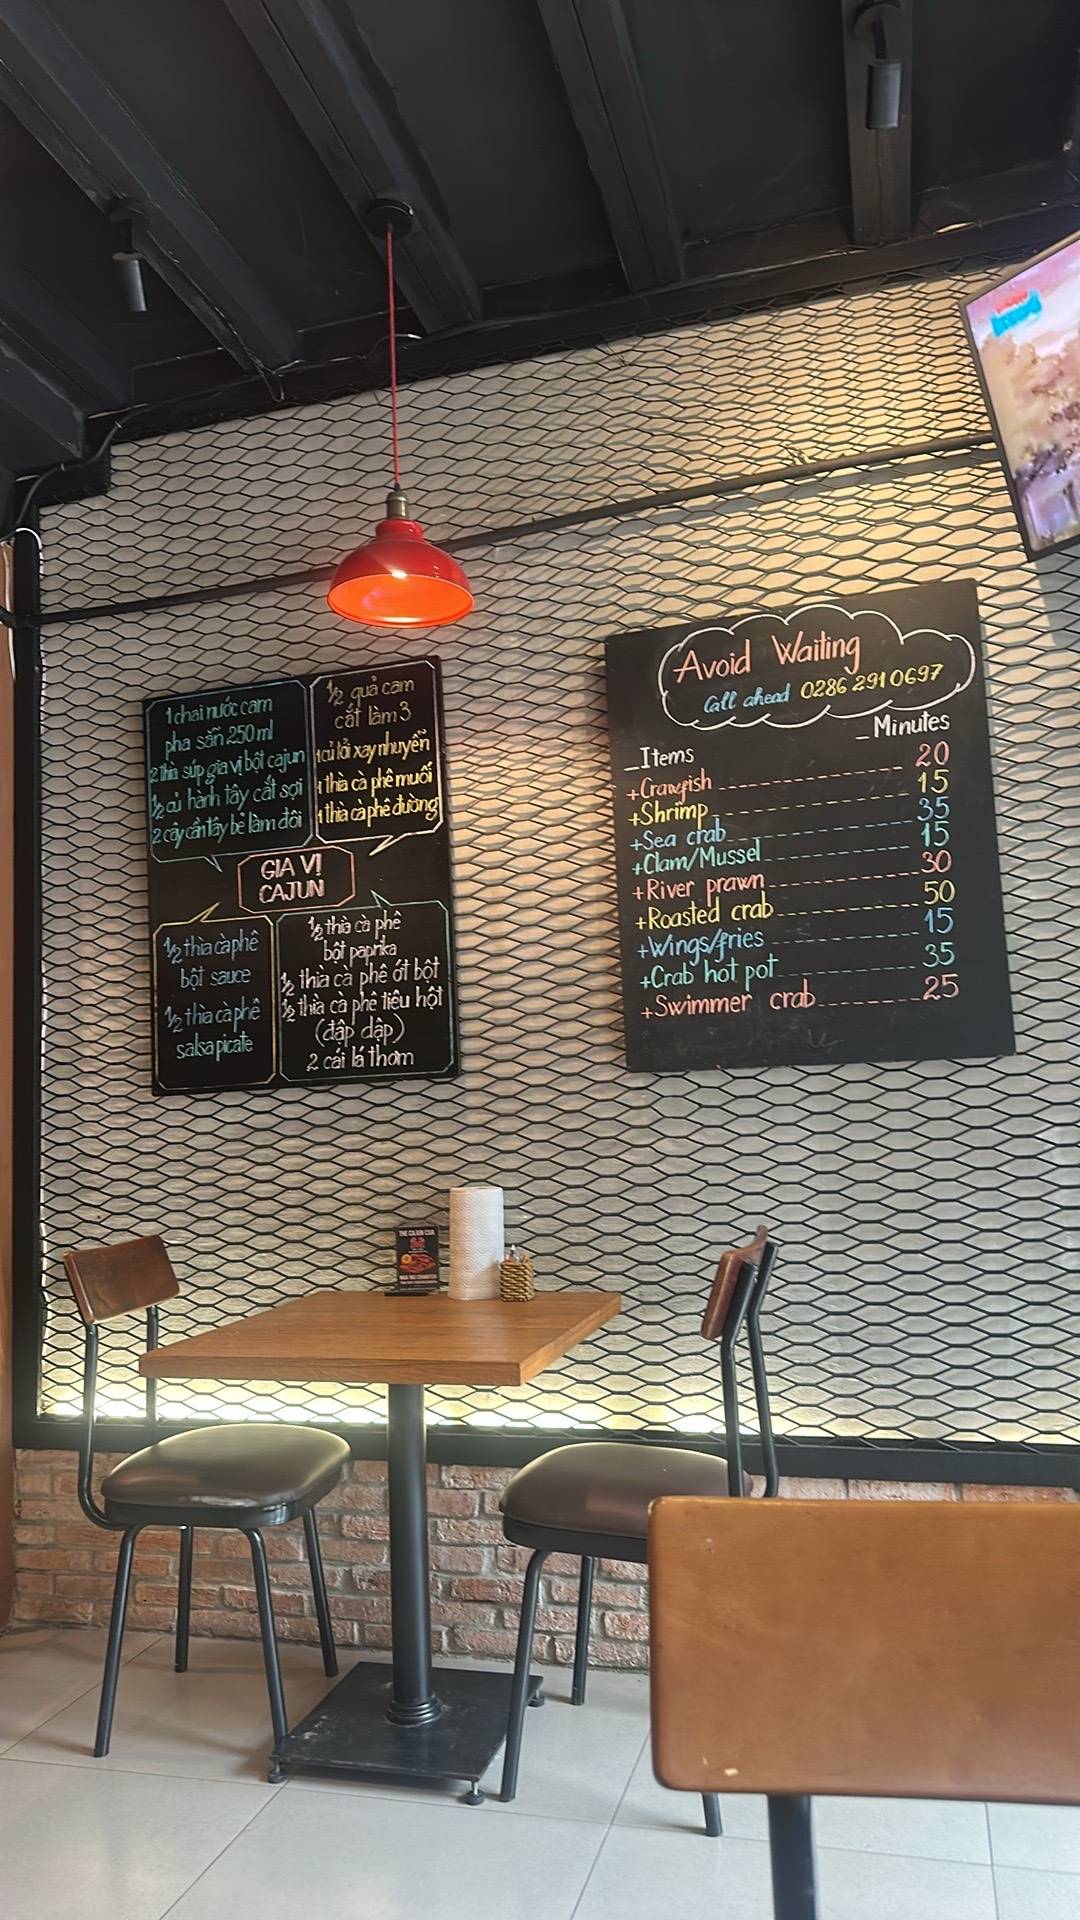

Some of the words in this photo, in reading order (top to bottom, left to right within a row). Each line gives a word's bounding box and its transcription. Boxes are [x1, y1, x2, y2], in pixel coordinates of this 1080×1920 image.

[672, 638, 751, 684] Avoid
[771, 630, 861, 674] Waiting
[350, 675, 379, 708] quả
[381, 679, 415, 695] cam
[703, 690, 737, 714] Call
[742, 683, 791, 708] ahead
[800, 677, 847, 700] 0286
[174, 704, 204, 724] chai
[240, 698, 273, 716] cam
[334, 702, 362, 729] cắt
[368, 705, 398, 726] làm
[399, 700, 412, 721] 3
[165, 731, 191, 760] pha
[226, 724, 255, 745] 250
[257, 719, 274, 741] ml
[353, 744, 377, 765] xay
[378, 728, 431, 760] nhuyễn
[915, 740, 950, 767] 20
[182, 759, 205, 786] súp
[205, 760, 229, 785] gia
[229, 756, 243, 776] vị
[244, 749, 264, 773] bột
[267, 748, 305, 773] cajun
[324, 771, 349, 794] thìa
[351, 770, 367, 791] cà
[371, 767, 394, 798] phê
[396, 761, 433, 787] muối
[917, 769, 949, 794] 15
[187, 785, 221, 810] hành
[224, 783, 250, 811] tây
[253, 774, 277, 802] cắt
[279, 778, 303, 800] sợi
[324, 800, 349, 824] thìa
[350, 798, 366, 821] cà
[367, 797, 391, 828] phê
[392, 793, 439, 821] đường
[152, 828, 162, 844] 2
[163, 821, 185, 849] cây
[206, 816, 229, 844] tây
[248, 811, 276, 833] làm
[278, 806, 303, 830] đôi
[686, 817, 727, 846] crab
[916, 796, 950, 822] 35
[921, 820, 950, 847] 15
[260, 857, 296, 880] GIA
[706, 873, 765, 907] prawn
[921, 849, 952, 874] 30
[259, 879, 325, 904] CAJUN
[731, 890, 774, 922] crab
[923, 879, 956, 905] 50
[325, 915, 351, 935] thìa
[354, 914, 371, 933] cà
[375, 910, 402, 940] phê
[924, 907, 954, 934] 15
[183, 935, 212, 957] thìa
[214, 932, 231, 955] cà
[231, 928, 259, 961] phê
[323, 940, 346, 964] bột
[350, 935, 397, 967] paprika
[180, 965, 205, 991] bột
[210, 968, 252, 986] sauce
[298, 964, 330, 989] thìa
[334, 964, 353, 987] cà
[360, 962, 388, 994] phê
[414, 956, 440, 984] bột
[704, 957, 739, 984] hot
[745, 952, 780, 992] pot
[922, 941, 956, 968] 35
[297, 993, 325, 1017] thìa
[330, 991, 348, 1014] cà
[352, 991, 378, 1025] phê
[380, 989, 410, 1010] tiêu
[416, 985, 444, 1010] hột
[769, 978, 816, 1011] crab
[923, 973, 960, 1000] 25
[184, 1002, 213, 1026] thìa
[215, 1001, 232, 1023] cà
[233, 995, 261, 1033] phê
[306, 1053, 319, 1072] 2
[323, 1047, 346, 1070] cái
[351, 1045, 365, 1068] lá
